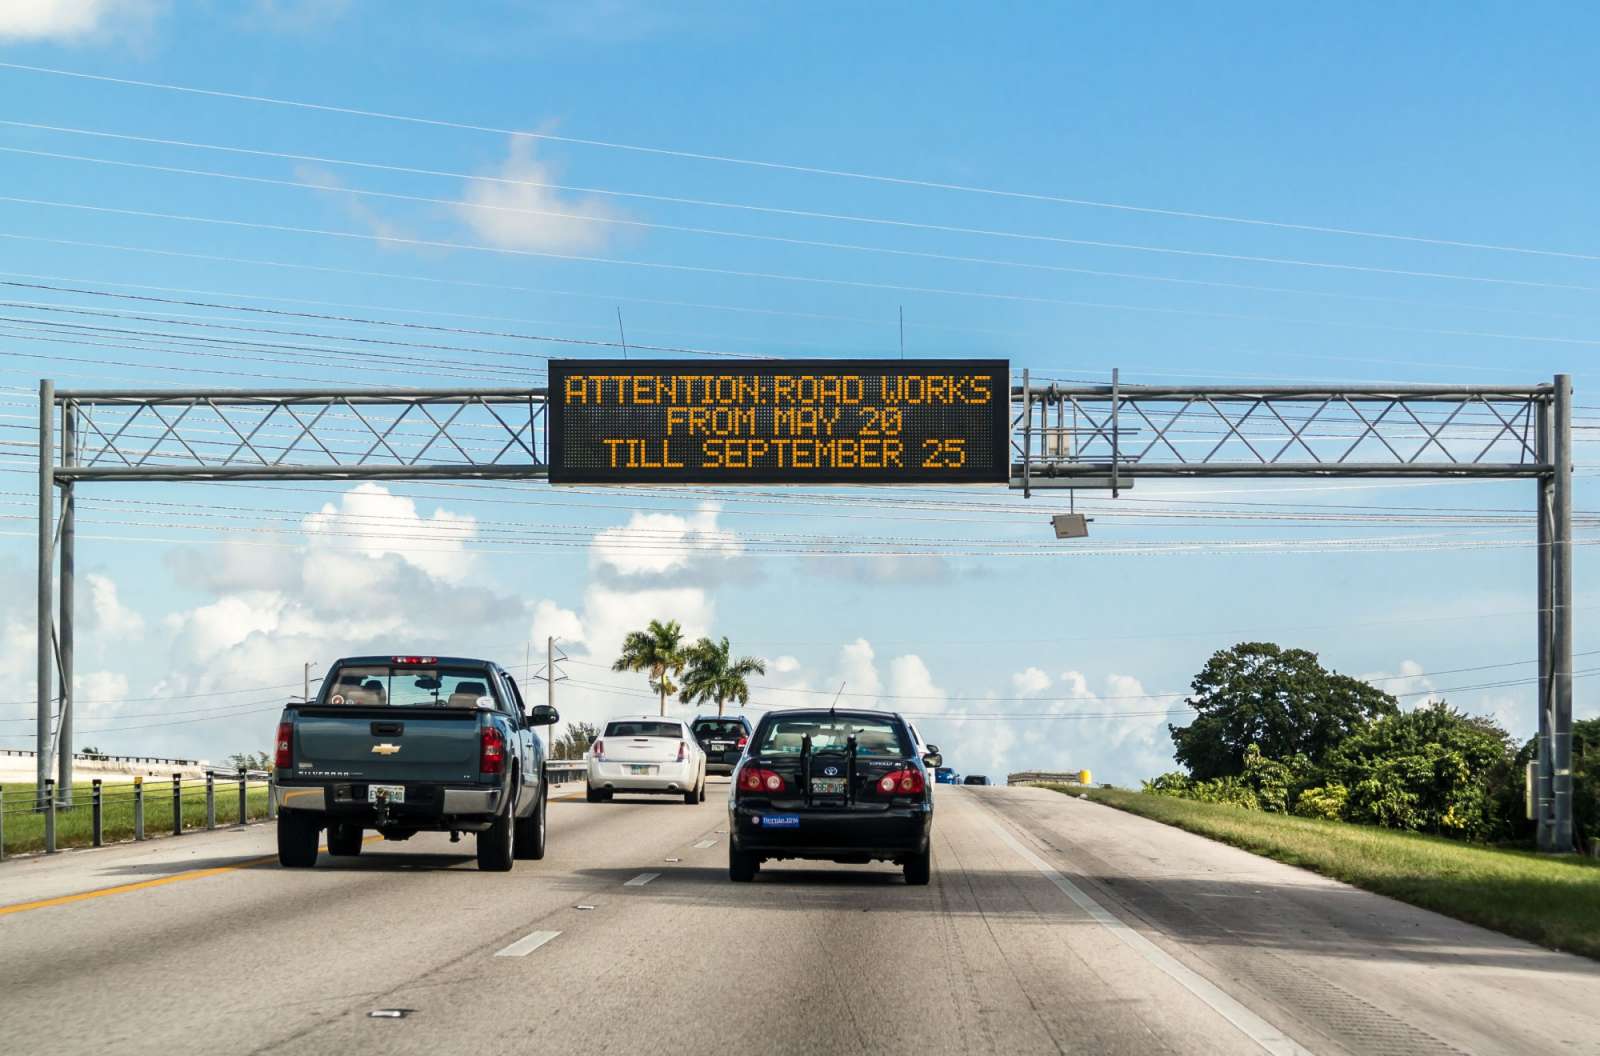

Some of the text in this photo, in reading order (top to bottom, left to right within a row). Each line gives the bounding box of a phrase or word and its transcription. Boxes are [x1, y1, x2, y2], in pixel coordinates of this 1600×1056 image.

[881, 375, 992, 404] WORKS
[666, 406, 903, 435] FROM MAY 20
[603, 438, 965, 468] TILL SEPTEMBER 25
